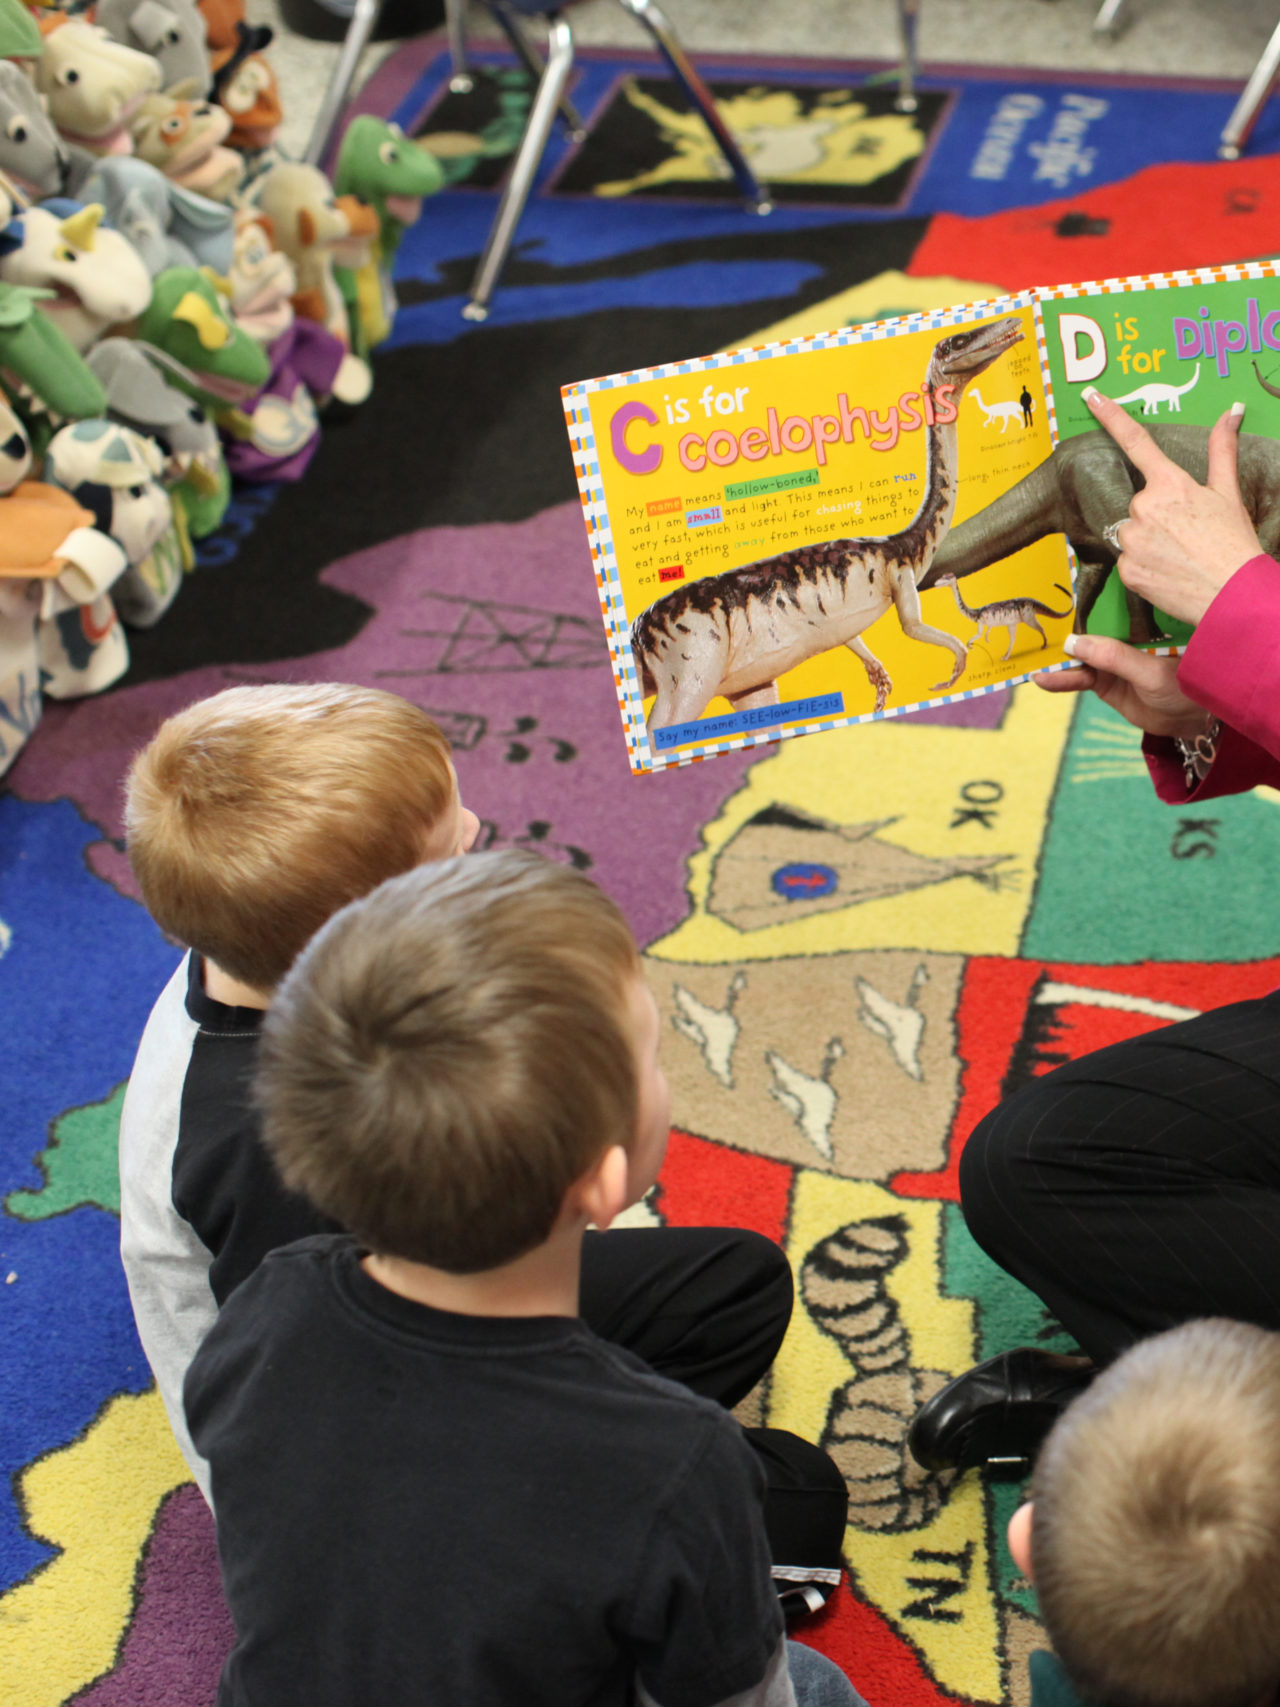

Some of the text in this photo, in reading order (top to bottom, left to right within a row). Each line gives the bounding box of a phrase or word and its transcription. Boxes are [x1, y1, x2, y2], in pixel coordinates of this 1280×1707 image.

[1058, 312, 1139, 383] D is
[1116, 344, 1166, 375] for
[610, 385, 749, 474] C is for
[678, 382, 959, 473] coelophysis
[626, 506, 644, 519] My
[649, 501, 681, 514] name
[685, 492, 722, 505] means
[629, 522, 651, 535] and
[666, 519, 682, 527] am
[687, 508, 720, 524] small
[725, 504, 746, 516] and
[787, 492, 812, 504] This
[818, 485, 854, 497] means
[869, 479, 889, 489] can
[893, 473, 917, 484] run
[632, 488, 919, 551] very fast, which is useful for chasing things to
[635, 557, 653, 568] eat
[659, 552, 680, 564] and
[685, 544, 729, 565] getting
[770, 530, 798, 542] from
[804, 523, 836, 536] those
[841, 517, 864, 529] who
[870, 509, 898, 523] want
[903, 506, 914, 516] to
[638, 566, 682, 585] eat me!
[658, 698, 840, 744] Say my name: SEE-low-FIE-sis
[949, 781, 1005, 829] OK
[1170, 818, 1222, 860] KS
[901, 1539, 976, 1624] TN
